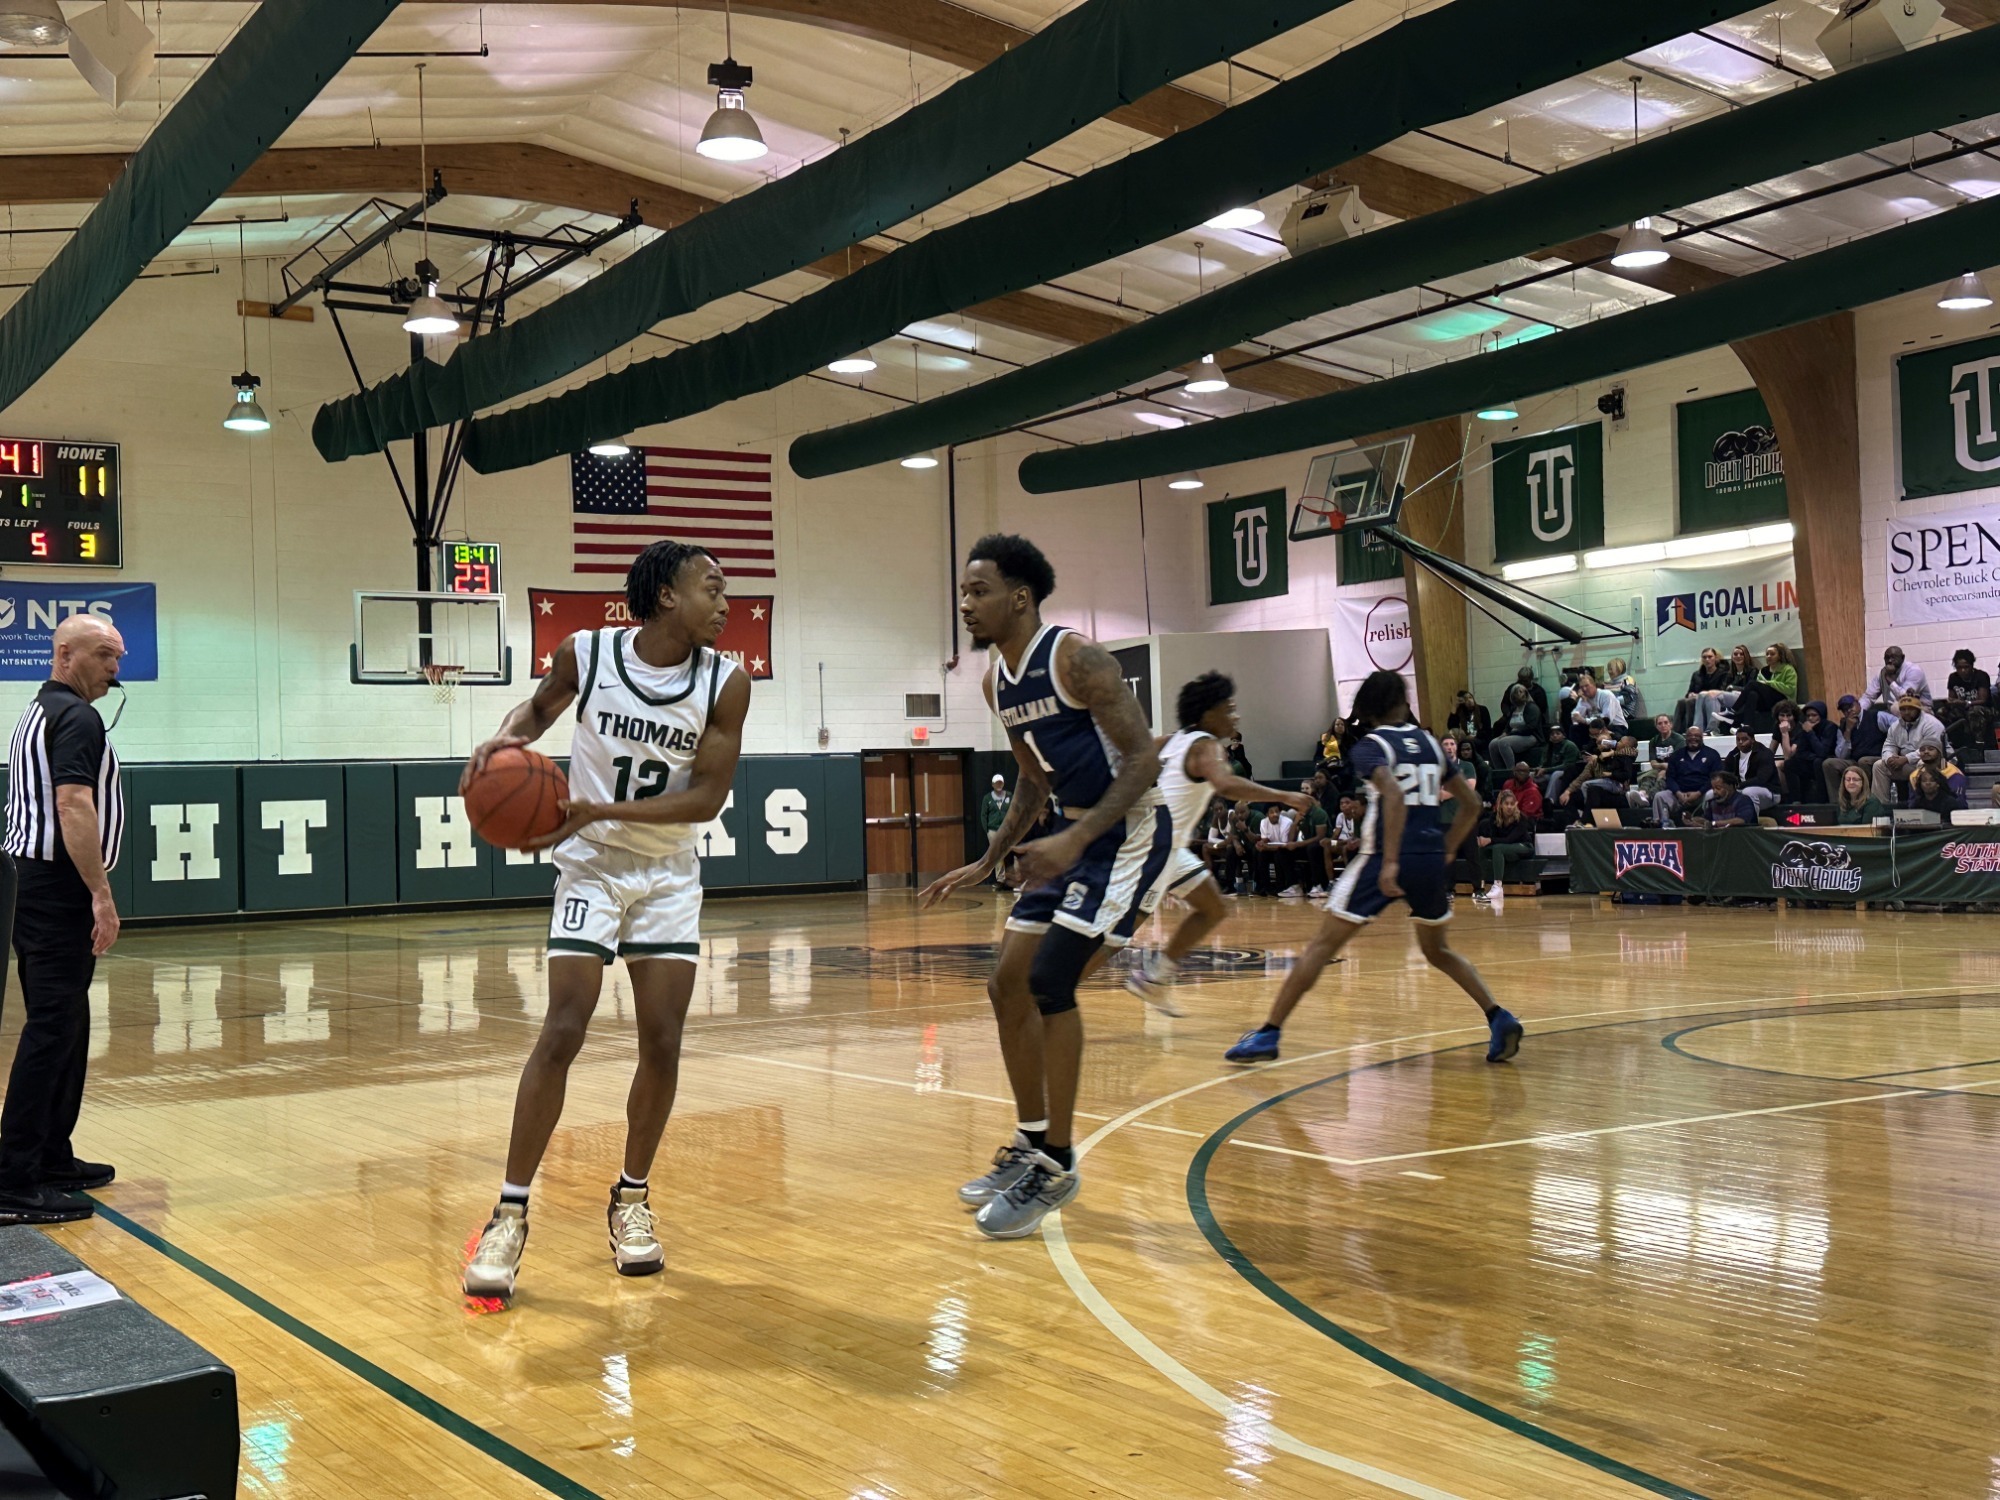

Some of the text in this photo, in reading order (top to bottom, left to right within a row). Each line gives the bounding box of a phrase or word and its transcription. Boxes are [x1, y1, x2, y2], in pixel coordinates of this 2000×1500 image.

[57, 446, 106, 461] HOME
[79, 465, 105, 497] 11
[1705, 451, 1784, 489] NIGHT HAWK
[14, 519, 39, 528] LEFT
[67, 521, 100, 530] FOULS
[31, 532, 47, 556] 5
[79, 534, 95, 558] 3
[455, 545, 495, 564] 13:41
[1891, 522, 2000, 574] SPEN
[454, 564, 490, 592] 23
[1893, 574, 1950, 592] Chevrolet
[1954, 569, 1988, 585] Buick
[27, 599, 114, 630] NTS
[1701, 612, 1800, 630] MINISTRI
[1369, 622, 1411, 642] relish
[598, 711, 698, 751] THOMAS
[1023, 730, 1055, 773] 1
[613, 755, 670, 803] 12
[1395, 763, 1441, 806] 20
[1615, 842, 1683, 879] NAIA
[1772, 863, 1861, 893] NIGHT HAWKS
